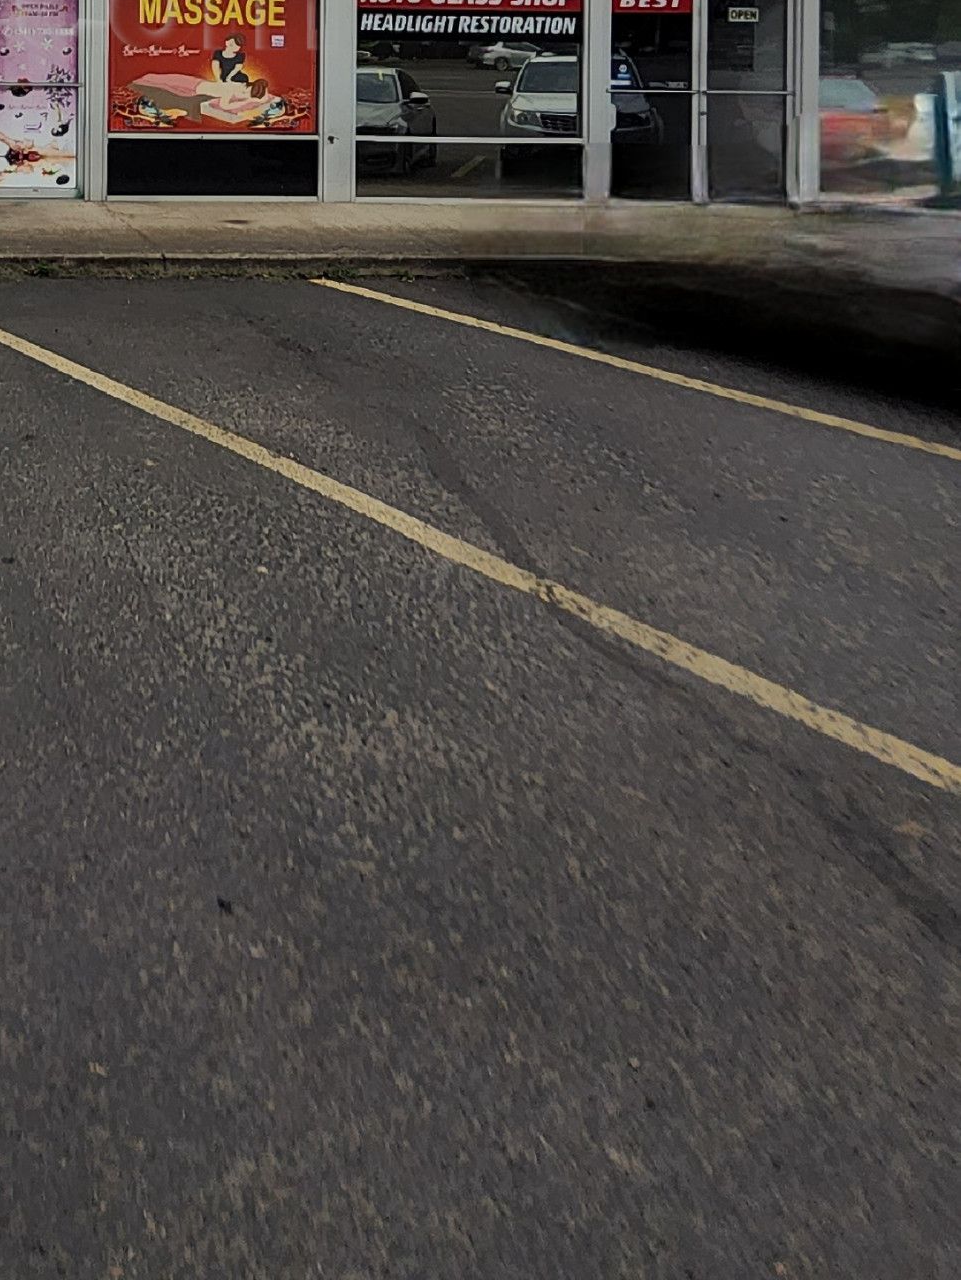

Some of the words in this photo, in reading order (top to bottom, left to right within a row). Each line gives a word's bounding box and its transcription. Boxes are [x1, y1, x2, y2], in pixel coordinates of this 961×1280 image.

[730, 9, 757, 21] OPEN
[360, 13, 458, 33] HEADLIGHT
[458, 16, 577, 35] RESTORATION
